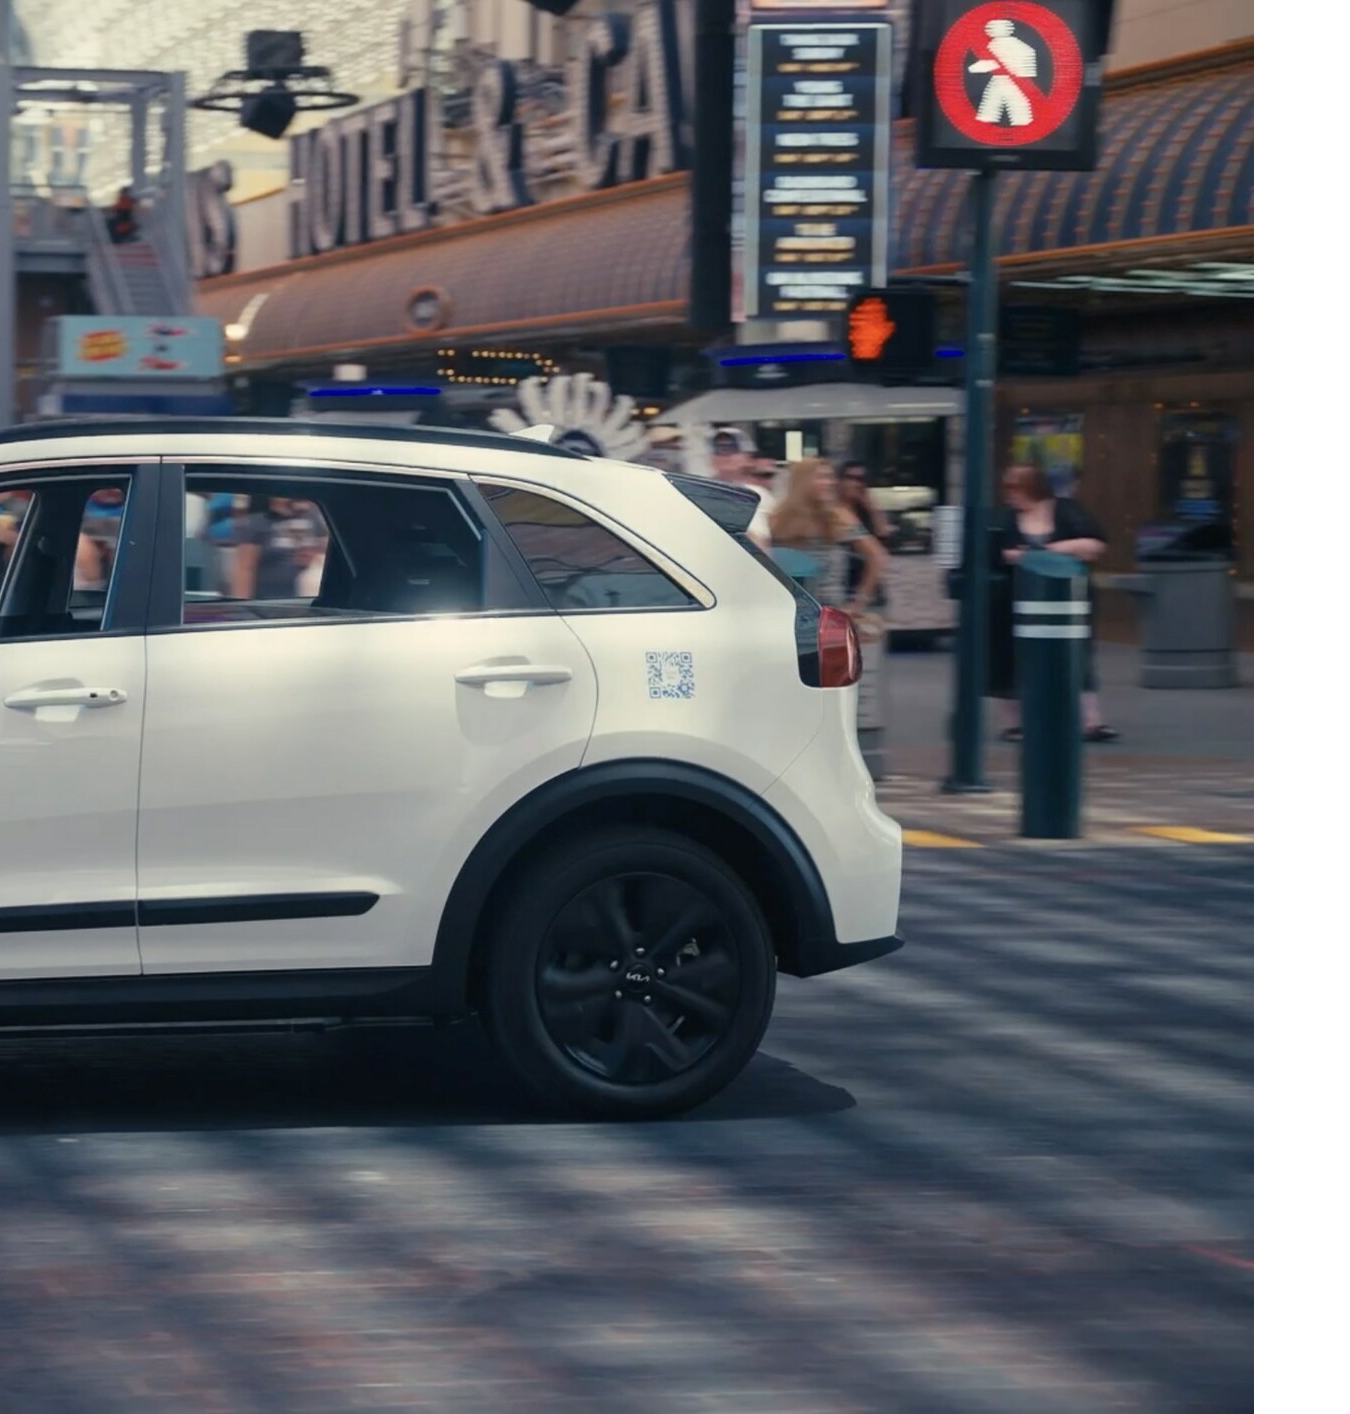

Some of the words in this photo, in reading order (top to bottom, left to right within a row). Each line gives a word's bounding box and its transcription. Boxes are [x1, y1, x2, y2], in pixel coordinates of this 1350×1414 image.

[290, 90, 437, 259] HOTEL
[470, 60, 530, 214] &
[574, 0, 684, 190] CA
